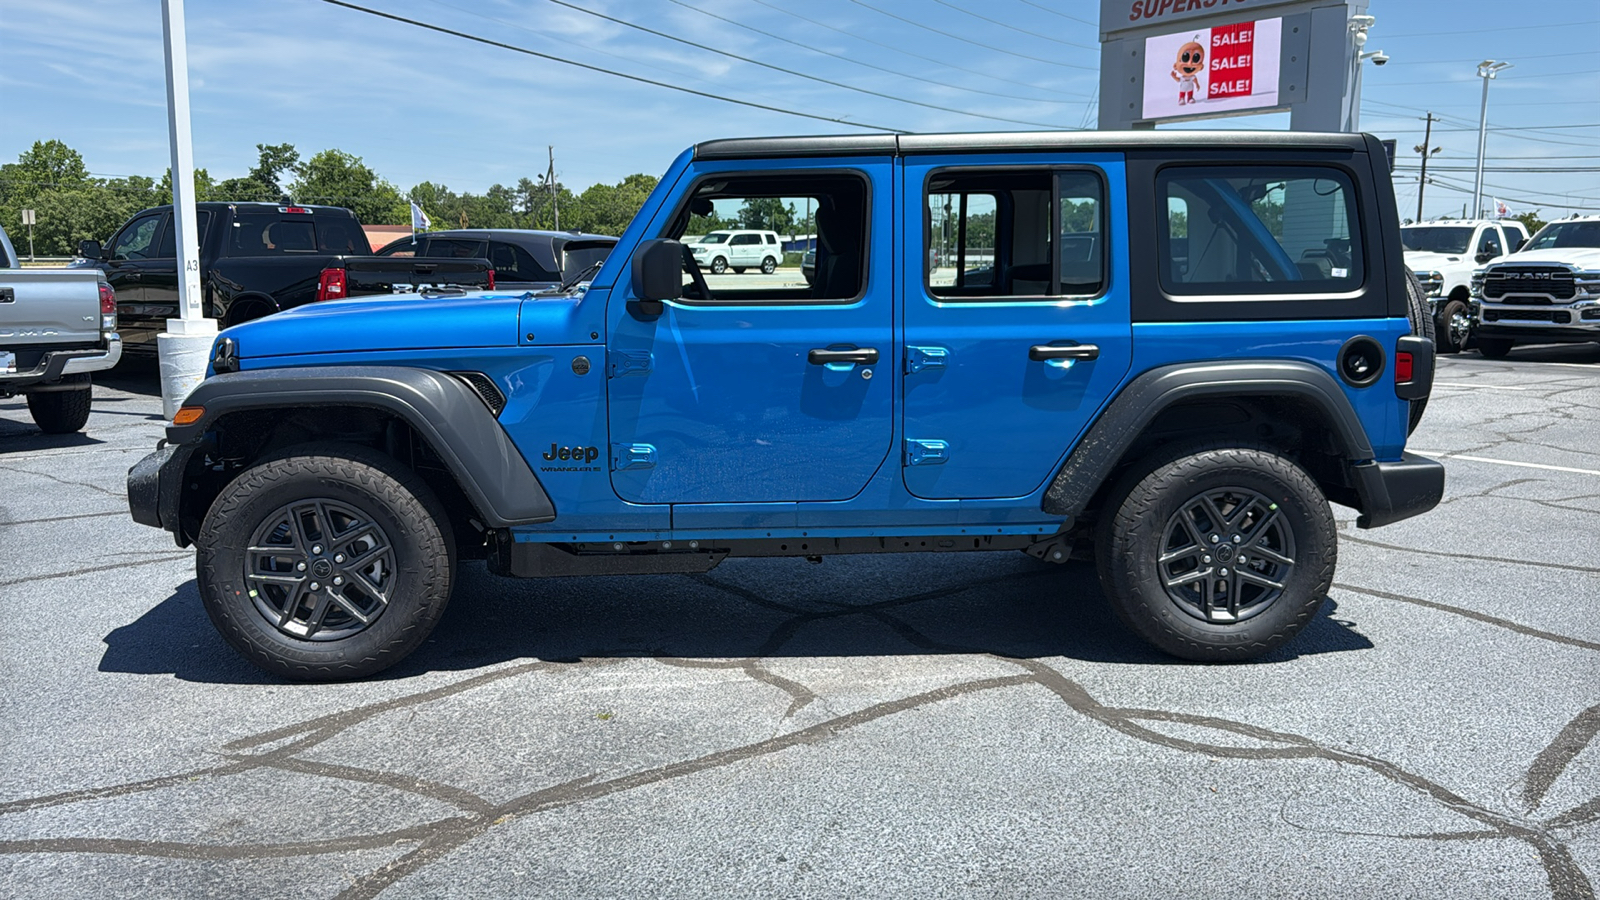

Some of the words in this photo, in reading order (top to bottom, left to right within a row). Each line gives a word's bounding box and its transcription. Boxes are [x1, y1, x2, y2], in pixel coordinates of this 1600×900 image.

[1129, 0, 1246, 21] SUPER
[1212, 30, 1252, 47] SALE!
[1211, 55, 1251, 71] SALE!
[1210, 79, 1250, 95] SALE!
[187, 259, 199, 271] A3
[1506, 272, 1550, 280] RAM
[543, 442, 599, 464] Jeep
